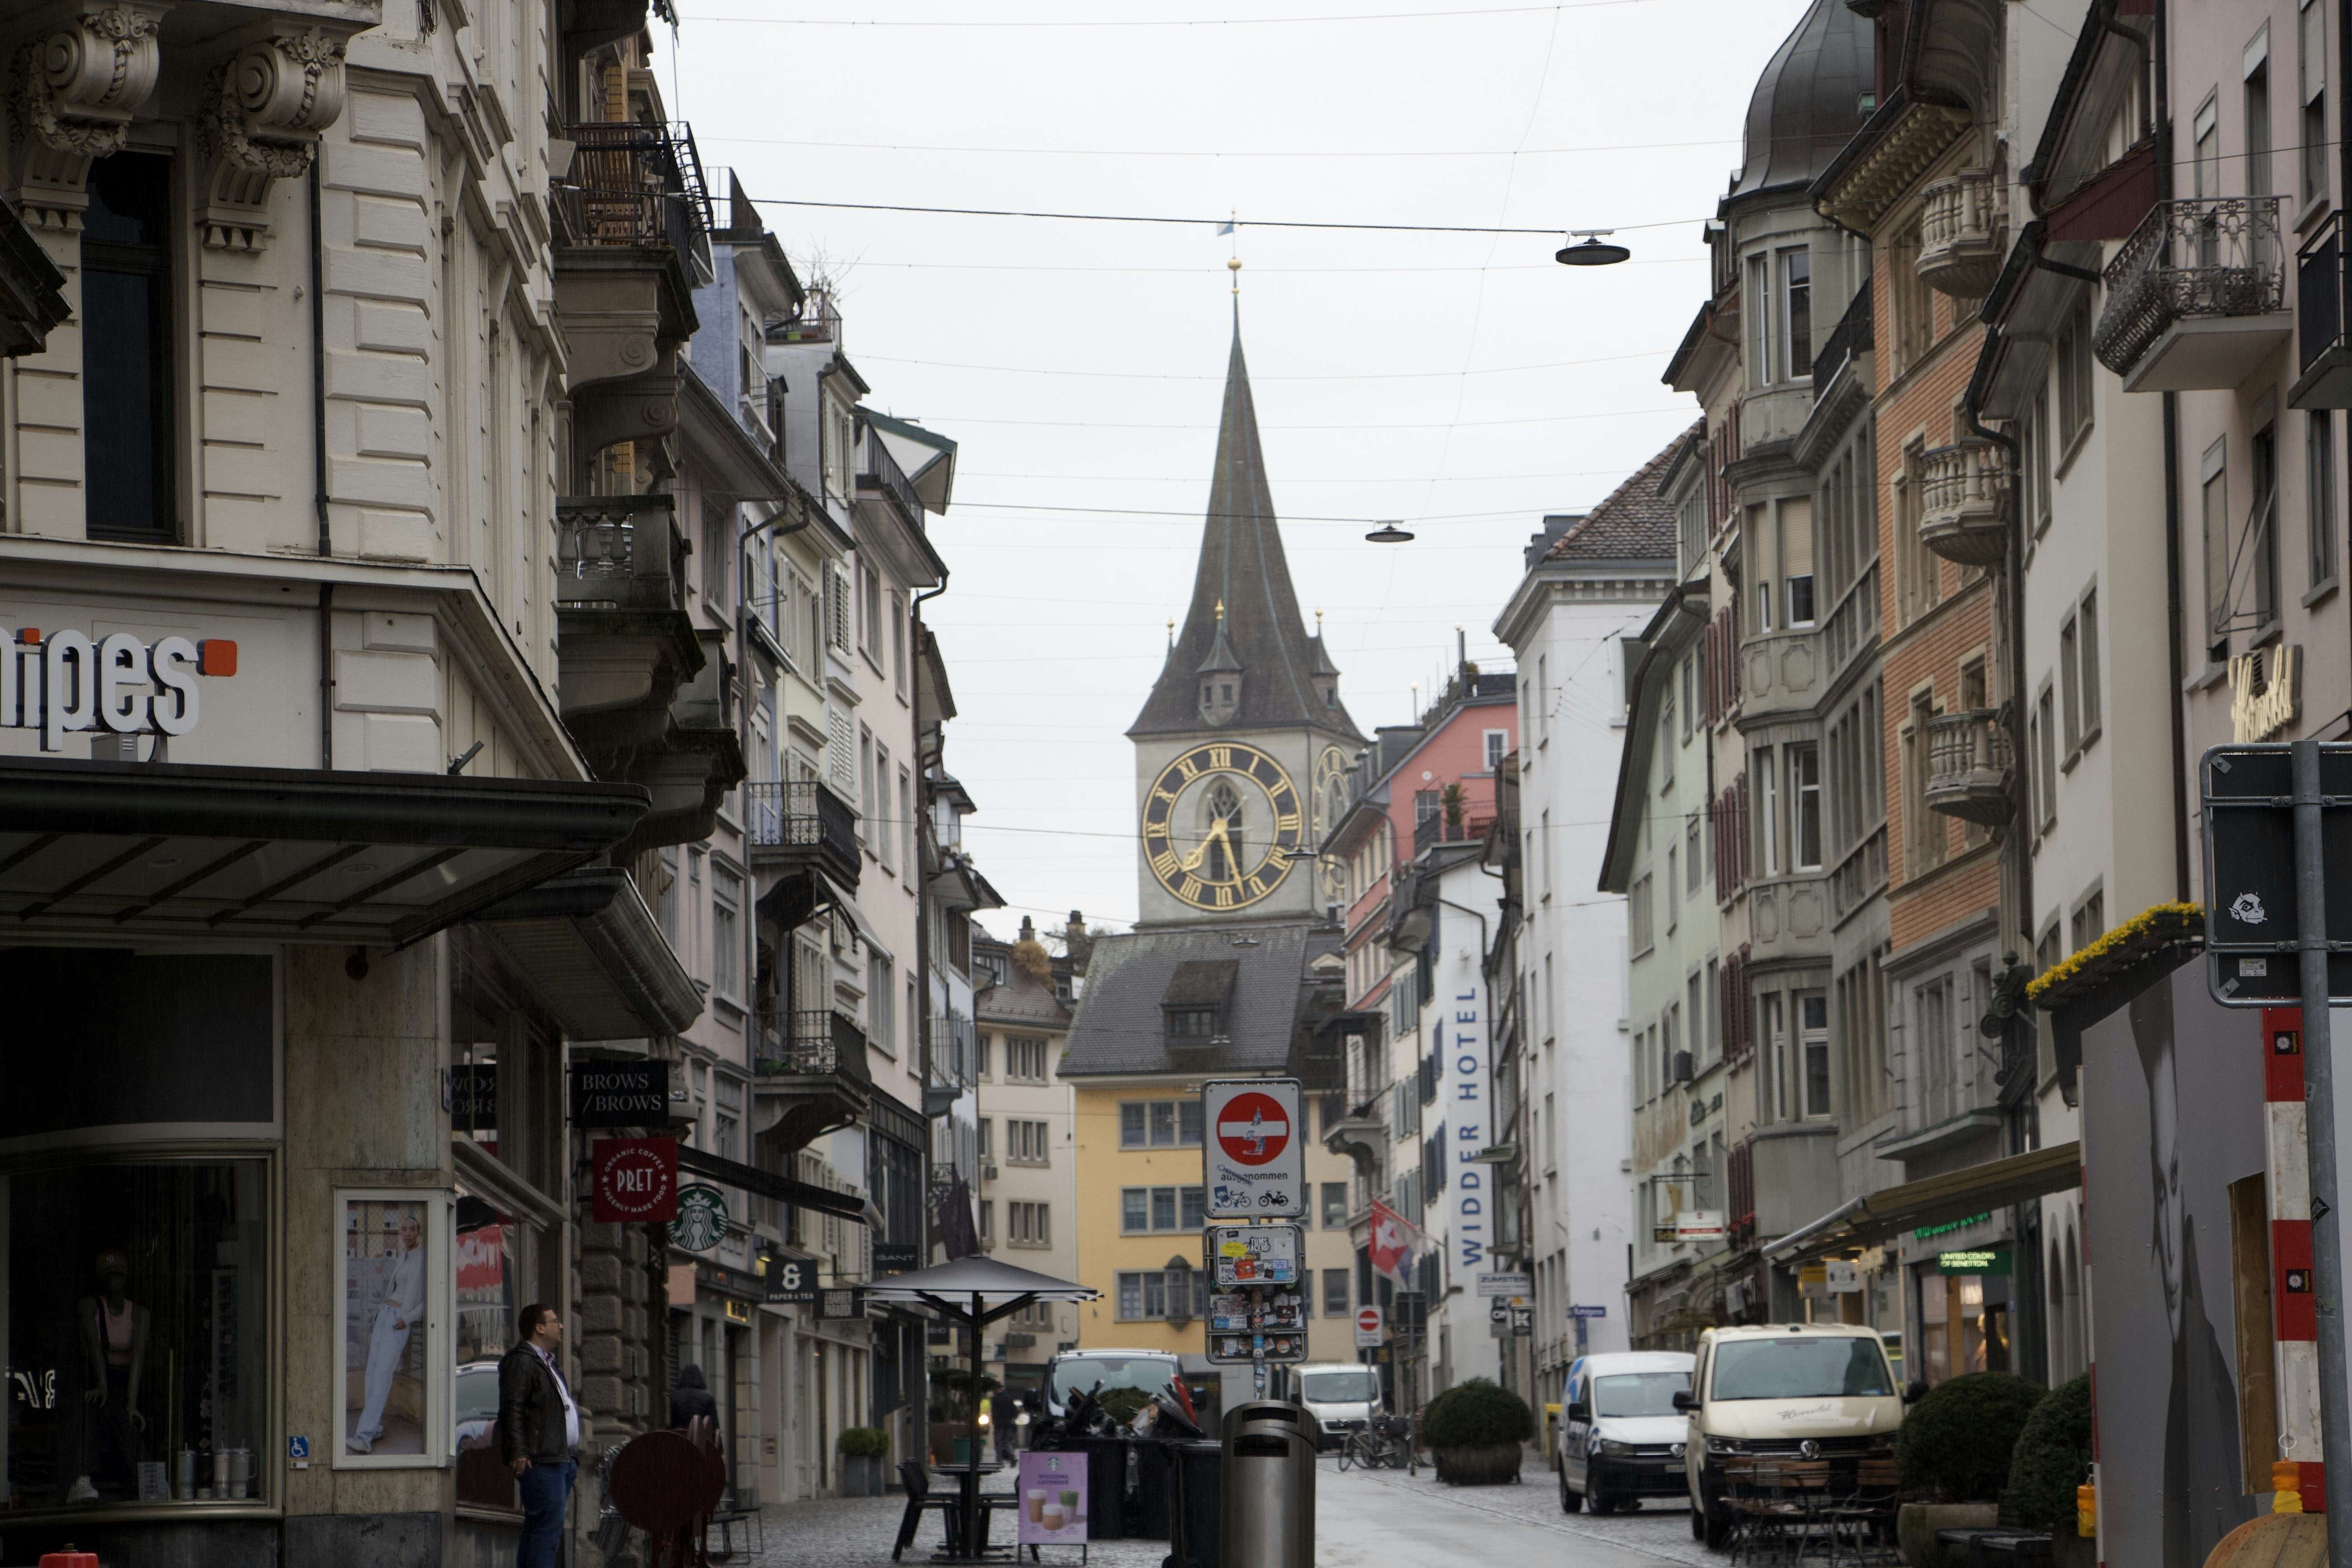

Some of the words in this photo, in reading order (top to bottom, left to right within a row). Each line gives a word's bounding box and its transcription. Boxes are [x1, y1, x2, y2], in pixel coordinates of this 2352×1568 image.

[1457, 987, 1478, 1100] HOTEL
[583, 1073, 648, 1089] BROWS
[604, 1147, 635, 1172] ORGANIC
[638, 1148, 665, 1170] COFFEE
[617, 1168, 653, 1192] PRET
[603, 1186, 629, 1212] FRESHLY
[631, 1202, 653, 1213] MADE
[652, 1185, 666, 1204] FOOD
[1460, 1125, 1482, 1266] WIDDER
[1776, 1404, 1832, 1420] Honold
